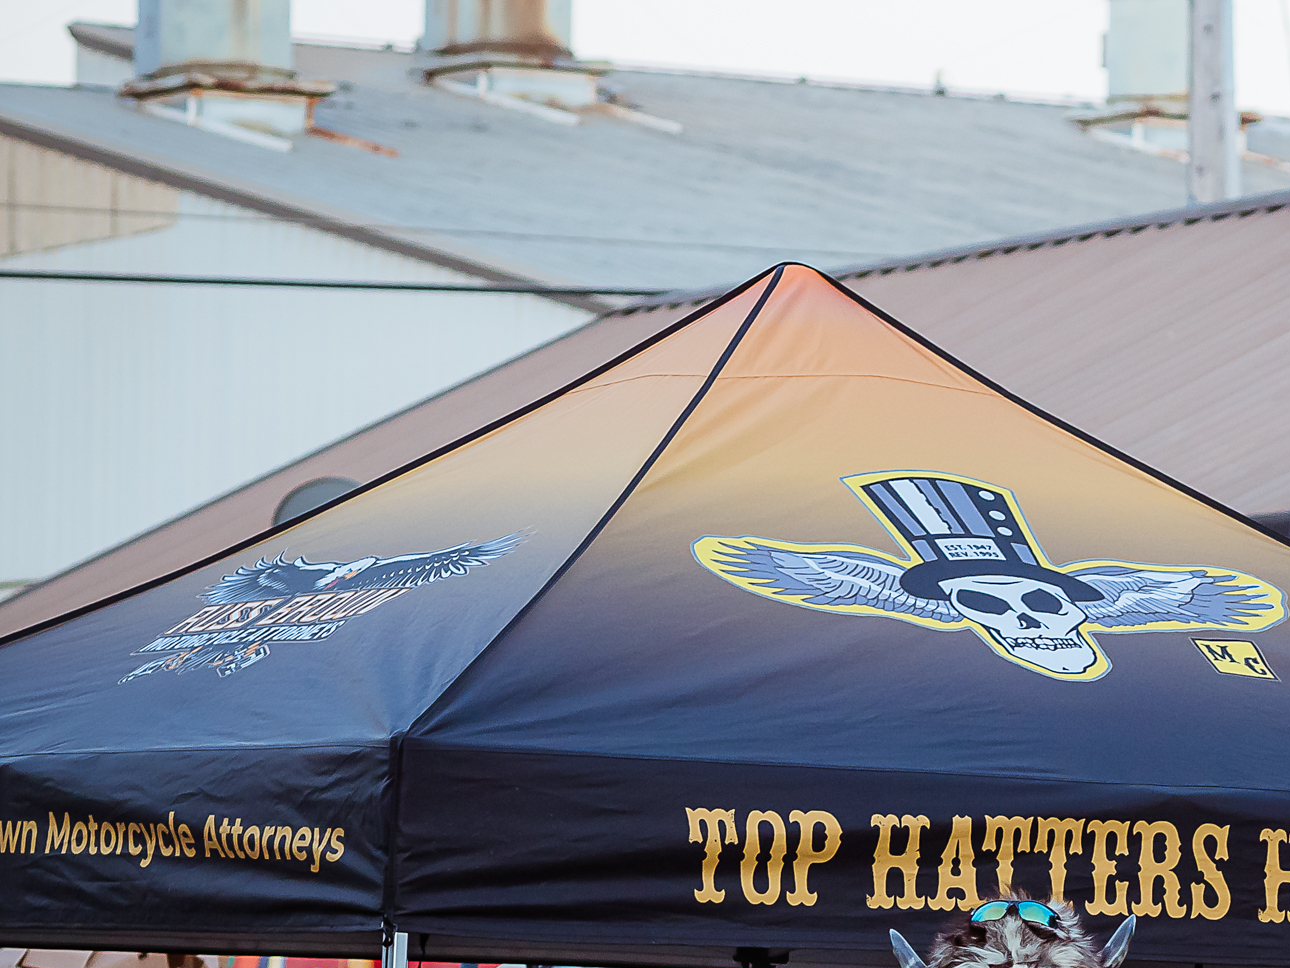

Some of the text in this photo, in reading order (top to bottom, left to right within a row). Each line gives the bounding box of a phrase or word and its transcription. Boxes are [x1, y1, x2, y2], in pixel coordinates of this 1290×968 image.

[1200, 643, 1241, 664] M
[45, 811, 197, 868] Motorcycle
[204, 814, 345, 873] Attorneys
[685, 807, 843, 906] TOP
[866, 813, 1231, 920] HATTERS
